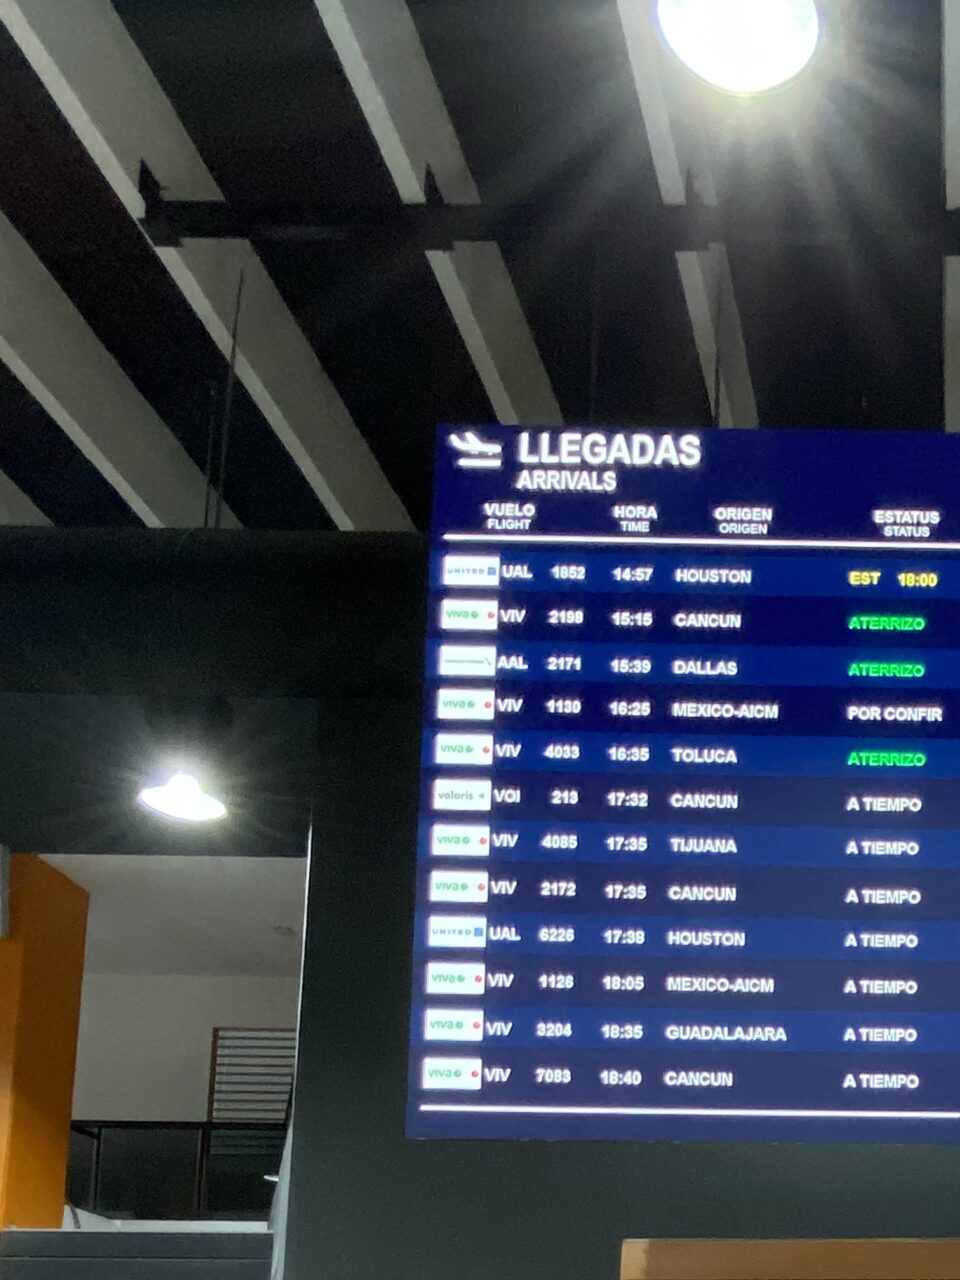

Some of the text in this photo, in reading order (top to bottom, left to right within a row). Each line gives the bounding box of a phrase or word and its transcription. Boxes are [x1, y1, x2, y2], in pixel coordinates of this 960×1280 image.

[519, 432, 700, 467] LLEGADAS
[516, 470, 616, 491] ARRIVALS
[484, 503, 535, 517] VUELO
[613, 505, 657, 519] HORA
[715, 507, 772, 521] ORIGEN
[874, 511, 940, 524] ESTATUS
[487, 518, 531, 529] FLIGHT
[620, 521, 649, 532] TIME
[719, 523, 767, 534] ORIGEN
[884, 526, 929, 537] STATUS
[502, 567, 533, 579] UAL
[551, 566, 585, 579] 1852
[613, 568, 653, 581] 14:57
[675, 569, 751, 583] HOUSTON
[849, 571, 881, 585] EST
[898, 573, 937, 587] 18:00
[500, 610, 526, 622] VIV
[612, 612, 652, 626] 15:15
[674, 613, 741, 627] CANCUN
[849, 616, 925, 630] ATERRIZO
[498, 657, 528, 669] AAL
[548, 657, 581, 670] 2171
[611, 659, 651, 673] 15:39
[673, 660, 737, 675] DALLAS
[849, 663, 925, 677] ATERRIZO
[497, 700, 942, 721] VIV 1130 16:25 MEXICO-AICM POR CONFIR
[495, 745, 521, 758] VIV
[544, 745, 579, 758] 4033
[609, 747, 649, 761] 16:35
[672, 748, 737, 763] TOLUCA
[848, 752, 926, 766] ATERRIZO
[494, 790, 520, 803] VOI
[552, 790, 578, 804] 213
[608, 792, 648, 806] 17:32
[670, 793, 738, 808] CANCUN
[847, 797, 859, 810] A
[862, 797, 922, 812] TIEMPO
[491, 881, 921, 904] VIV 2172 17:35 CANCUN A TIEMPO
[486, 1023, 917, 1042] VIV 3204 18:35 GUADALAJARA A TIEMPO
[485, 1068, 919, 1088] VIV 7083 18:40 CANCUN A TIEMPO
